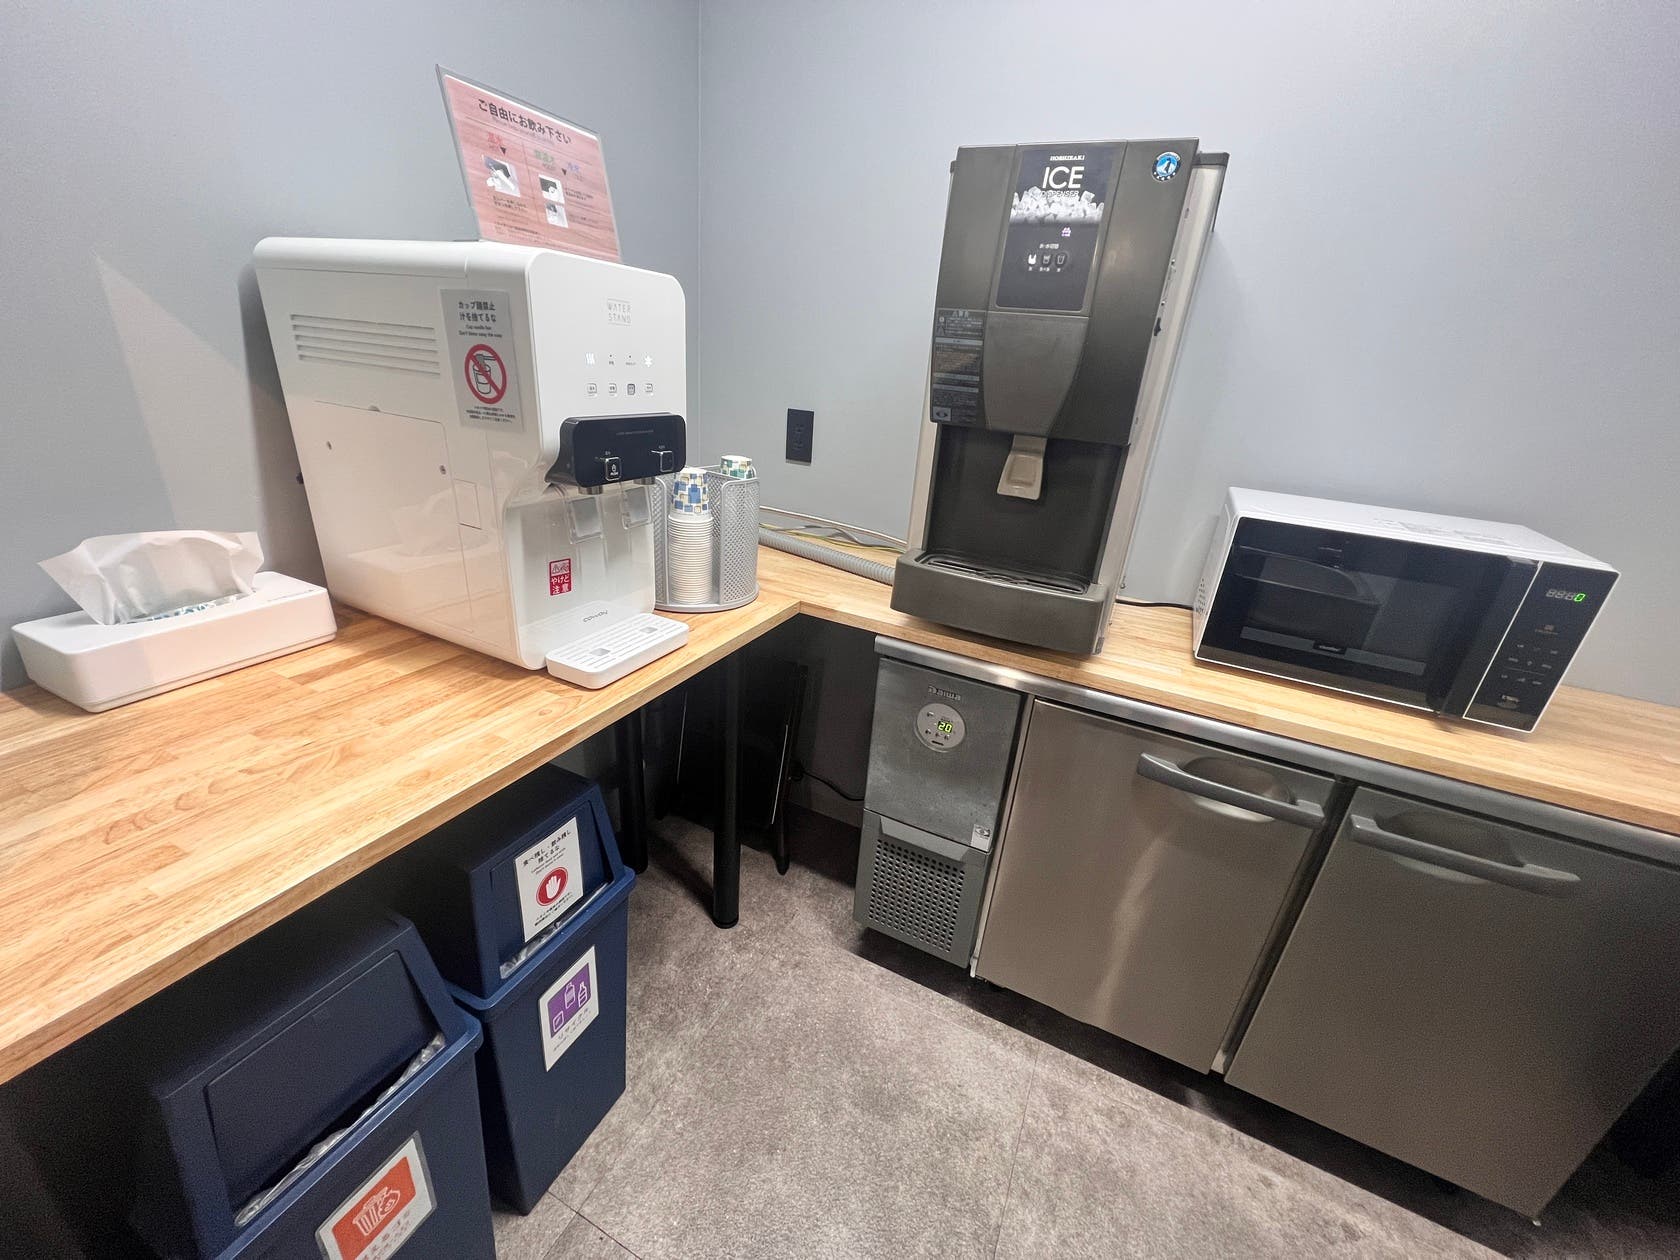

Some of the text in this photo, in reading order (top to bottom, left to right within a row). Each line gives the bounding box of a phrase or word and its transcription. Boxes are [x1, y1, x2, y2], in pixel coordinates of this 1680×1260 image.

[478, 98, 572, 144] ご自由にお飲み下さい
[1042, 165, 1085, 189] ICE
[1041, 190, 1080, 198] DISPENSER
[608, 303, 631, 313] WATER
[608, 312, 631, 324] STAND
[551, 574, 570, 585] やけど
[938, 721, 953, 733] 20
